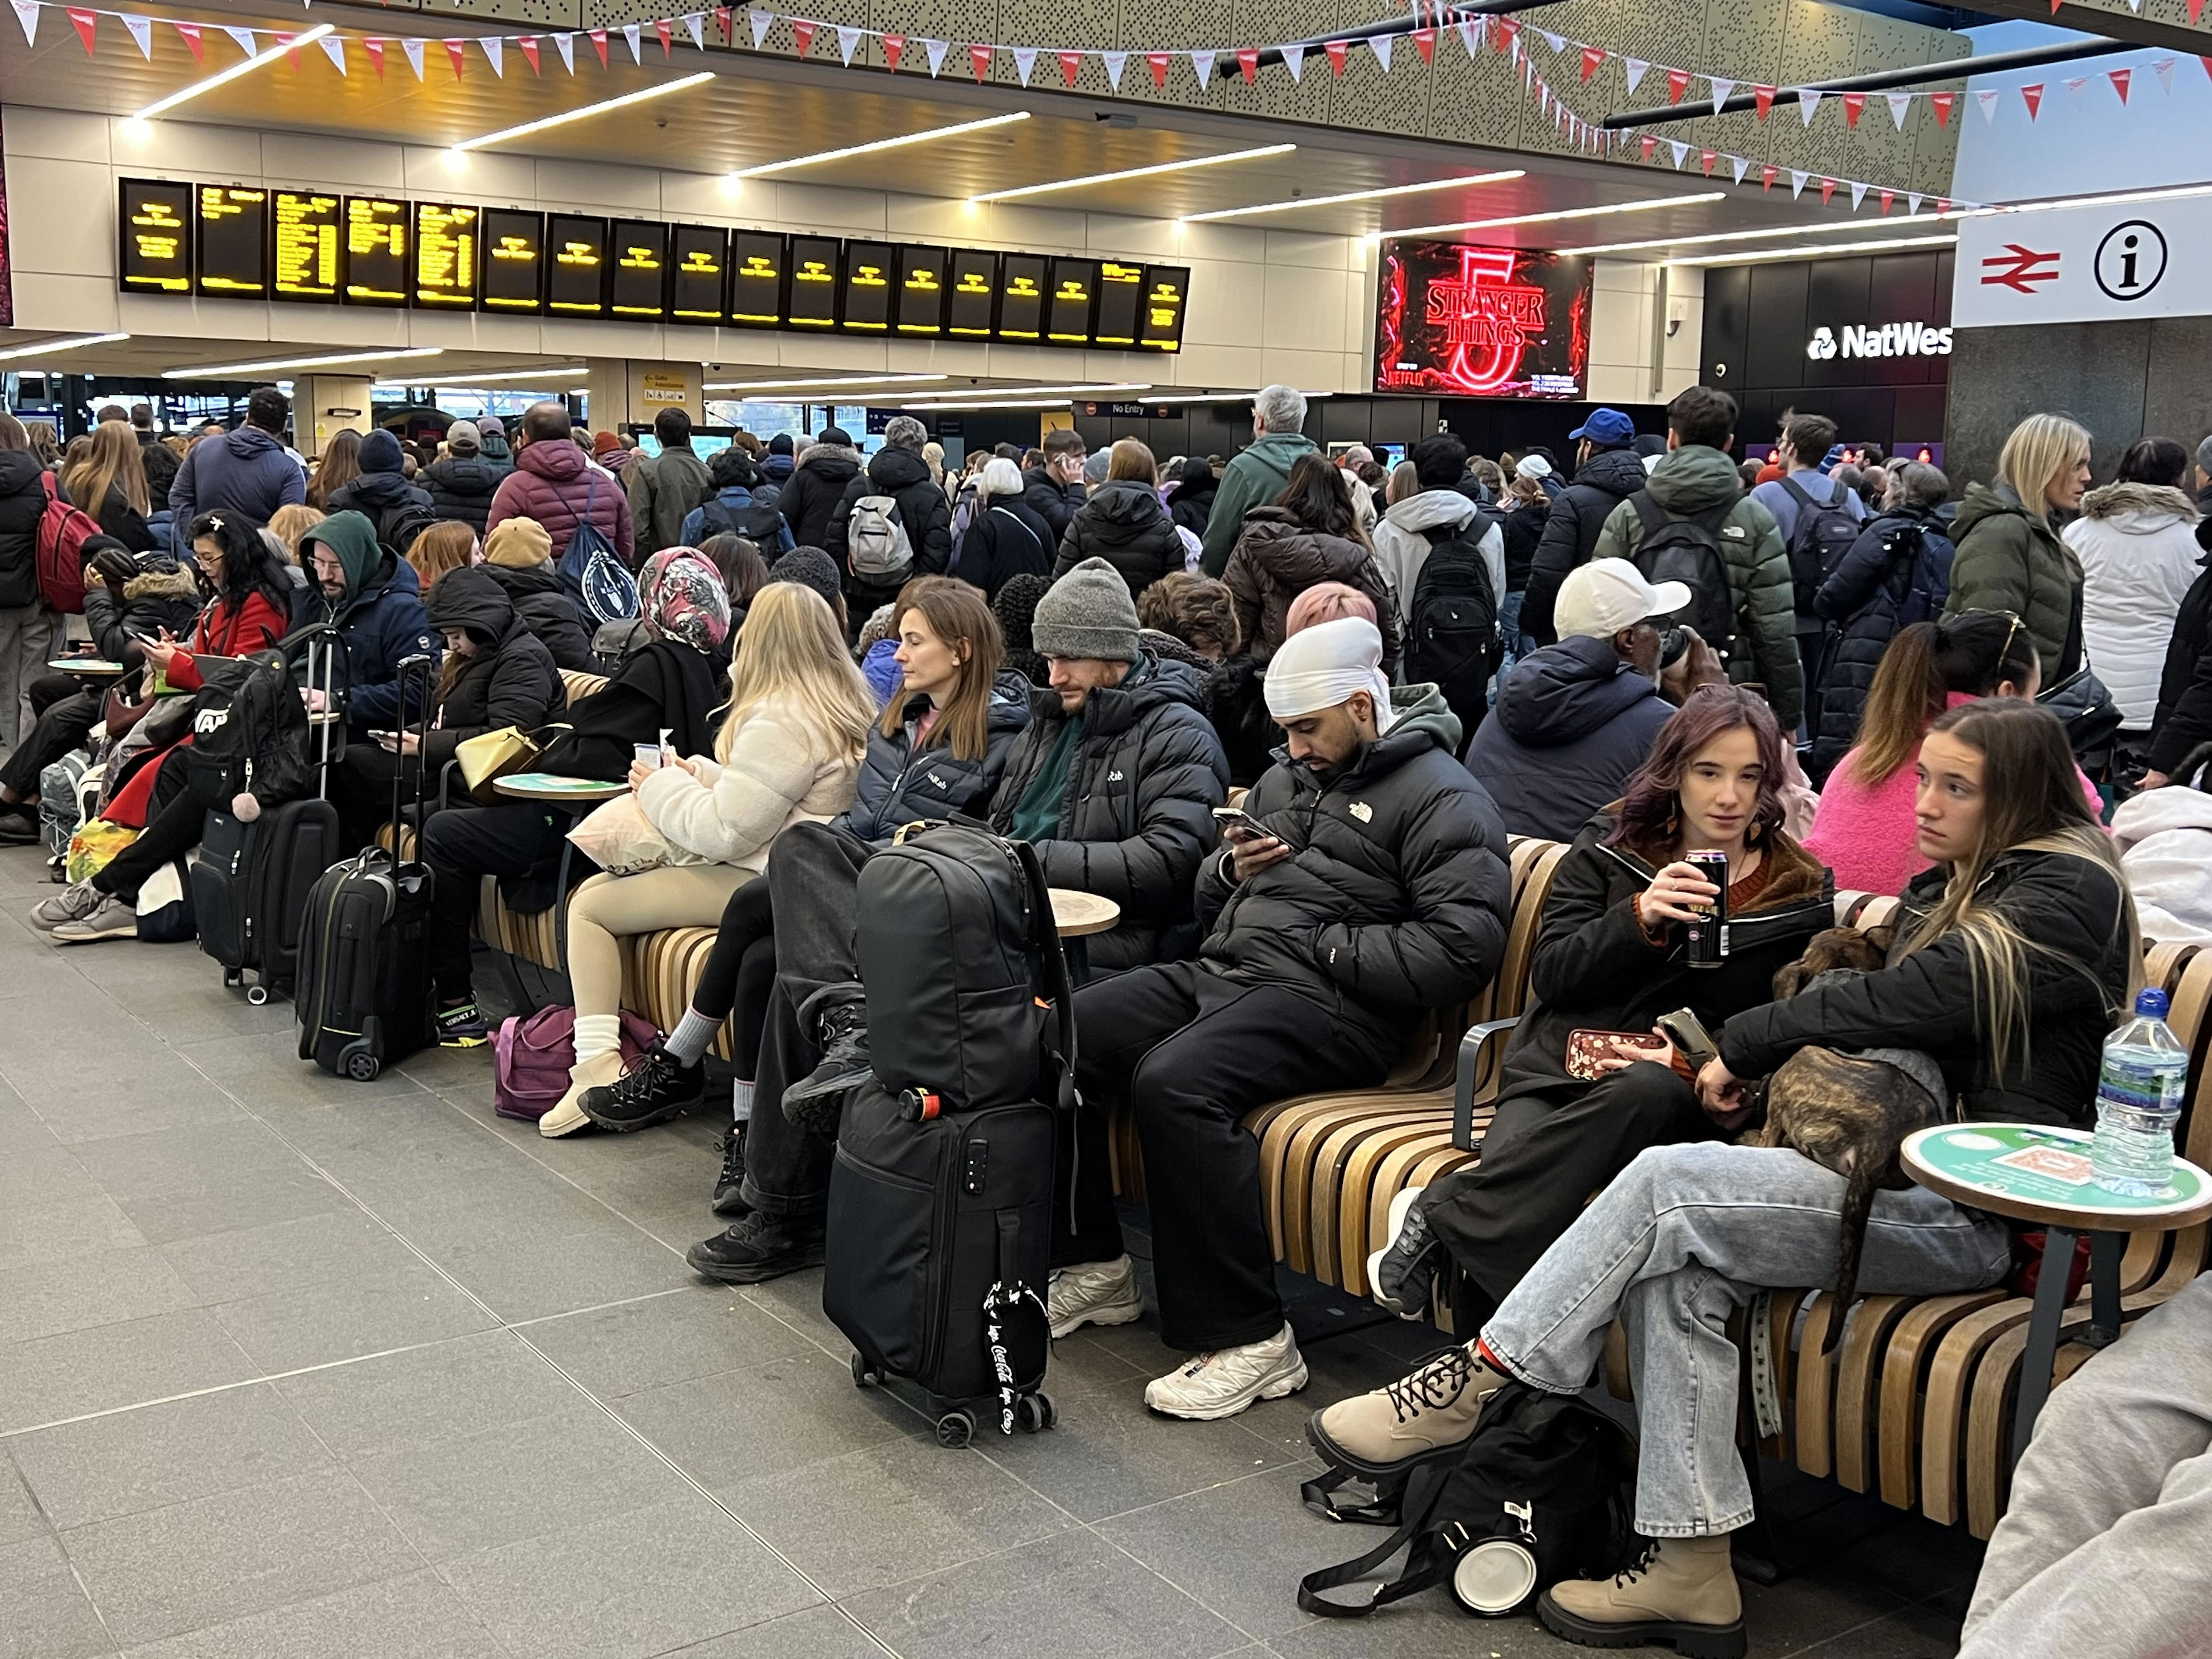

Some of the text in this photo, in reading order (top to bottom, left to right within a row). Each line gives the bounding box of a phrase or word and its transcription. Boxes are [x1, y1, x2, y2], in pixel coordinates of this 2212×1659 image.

[1427, 285, 1545, 326] STRANGER
[1447, 316, 1526, 347] THINGS
[1843, 321, 1953, 358] NatWes
[1387, 370, 1424, 387] NETFLIX
[1112, 404, 1144, 415] No Entry
